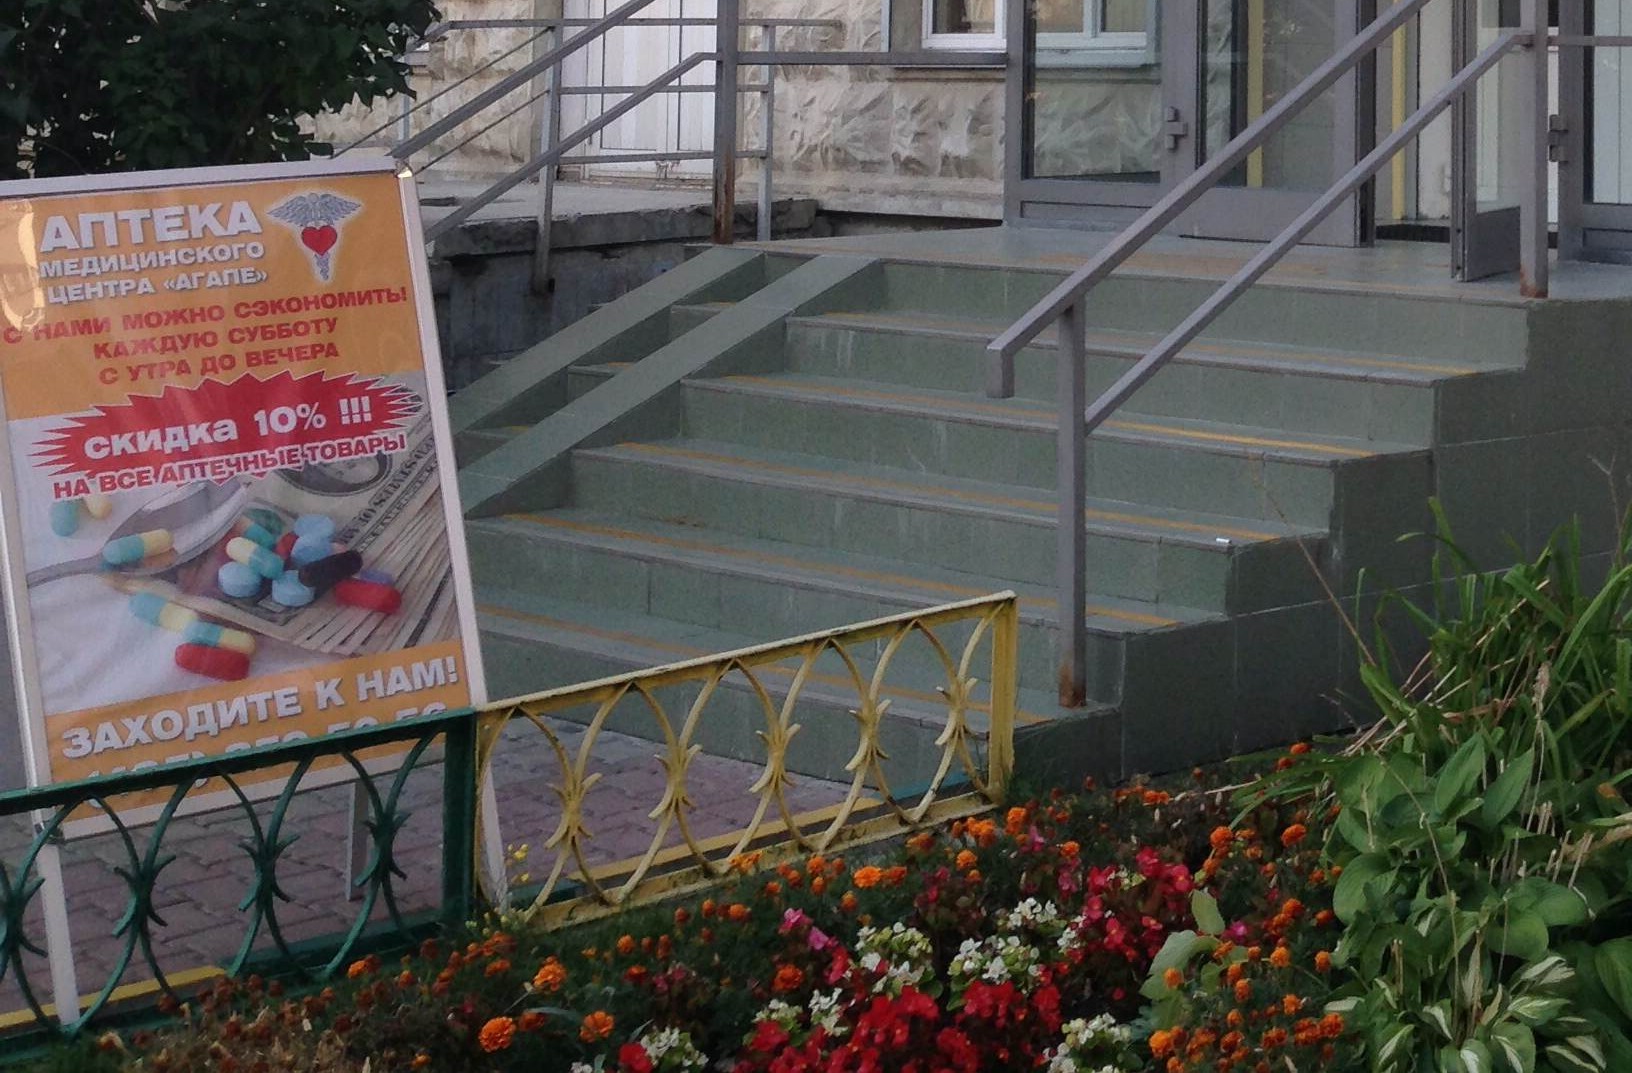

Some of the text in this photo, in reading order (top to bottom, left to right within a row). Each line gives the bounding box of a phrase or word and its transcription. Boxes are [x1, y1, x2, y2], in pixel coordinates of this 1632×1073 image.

[40, 200, 263, 252] АПТЕКА
[39, 241, 265, 278] МЕДИЦИНСКОГО
[48, 267, 268, 305] ЦЕНТРА «АГАПЕ»
[3, 286, 408, 344] С НАМИ МОЖНО СЭКОНОМИТЬ!
[94, 317, 338, 360] КАЖДУЮ СУББОТУ
[99, 342, 340, 385] С УТРА ДО ВЕЧЕРА
[254, 402, 327, 437] 10%
[53, 434, 407, 500] НА ВСЕ АПТЕЧНЫЕ ТОВАРЫ
[62, 687, 302, 760] ЗАХОДИТЕ
[315, 677, 346, 710] К
[356, 656, 458, 701] НАМ!
